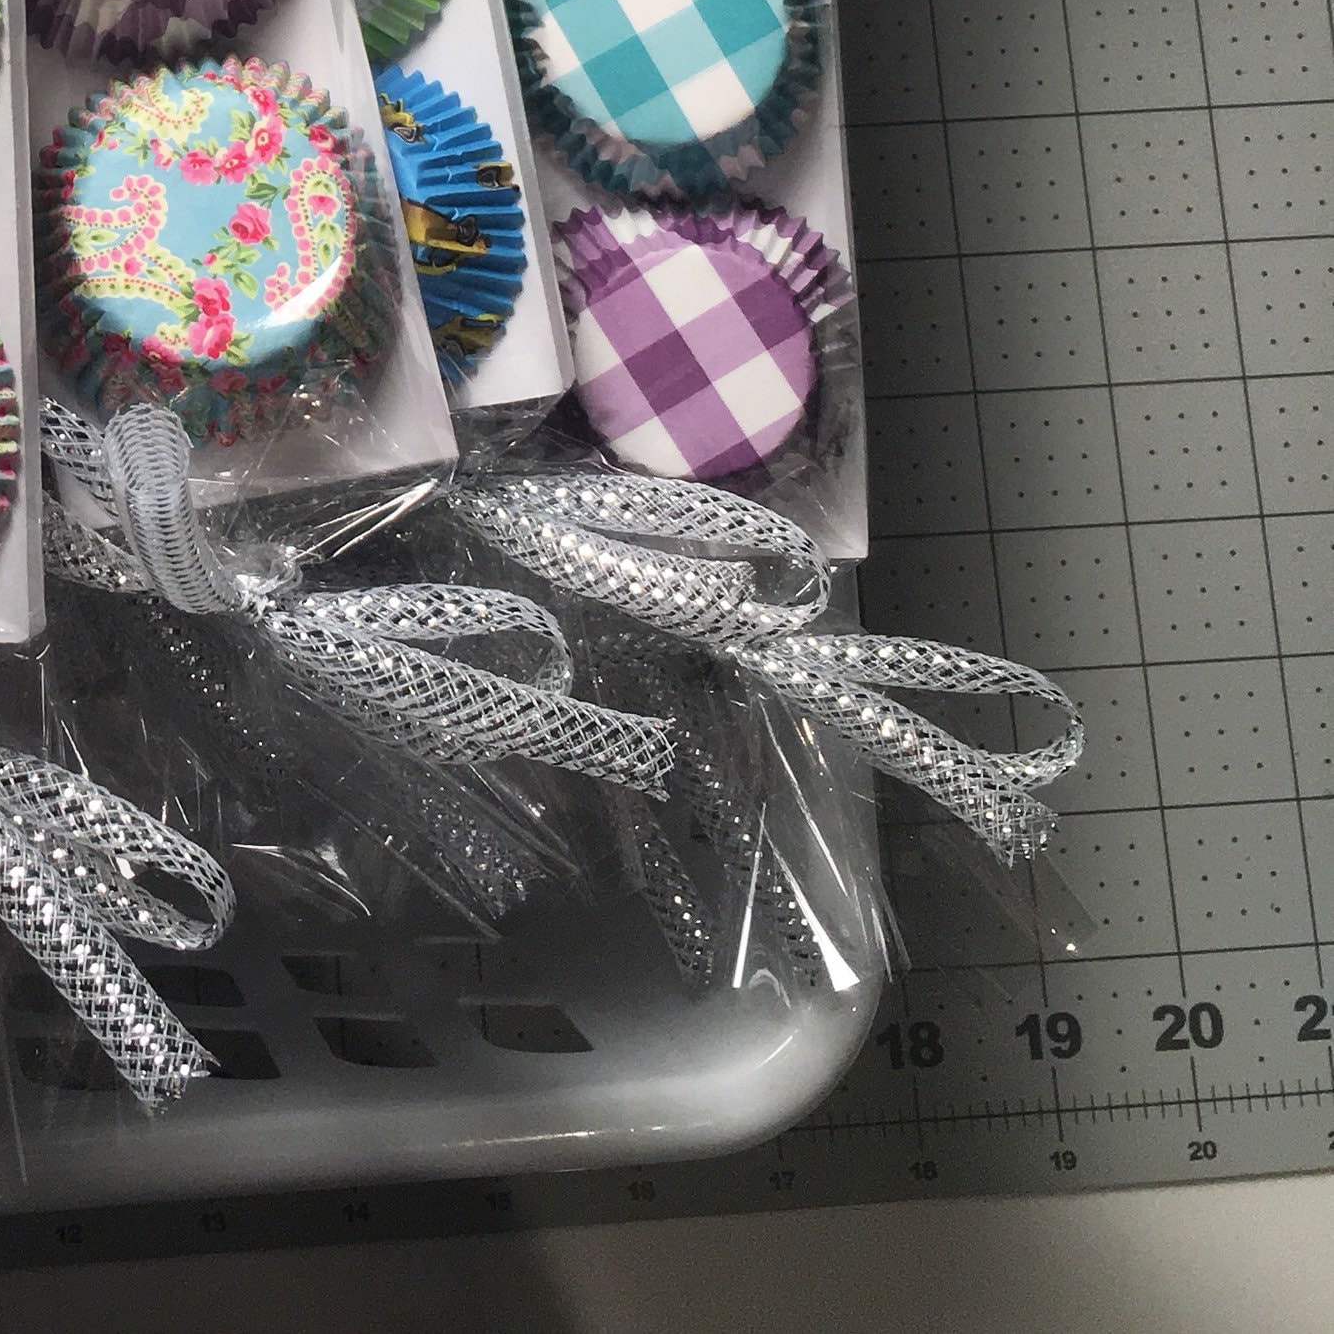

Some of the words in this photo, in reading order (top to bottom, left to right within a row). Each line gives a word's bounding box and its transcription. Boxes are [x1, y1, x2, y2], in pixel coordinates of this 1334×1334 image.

[875, 1020, 945, 1070] 18
[1015, 1012, 1083, 1061] 19
[1152, 1001, 1225, 1052] 20
[1293, 993, 1334, 1043] 2
[1049, 1150, 1078, 1171] 19
[1187, 1139, 1218, 1162] 20
